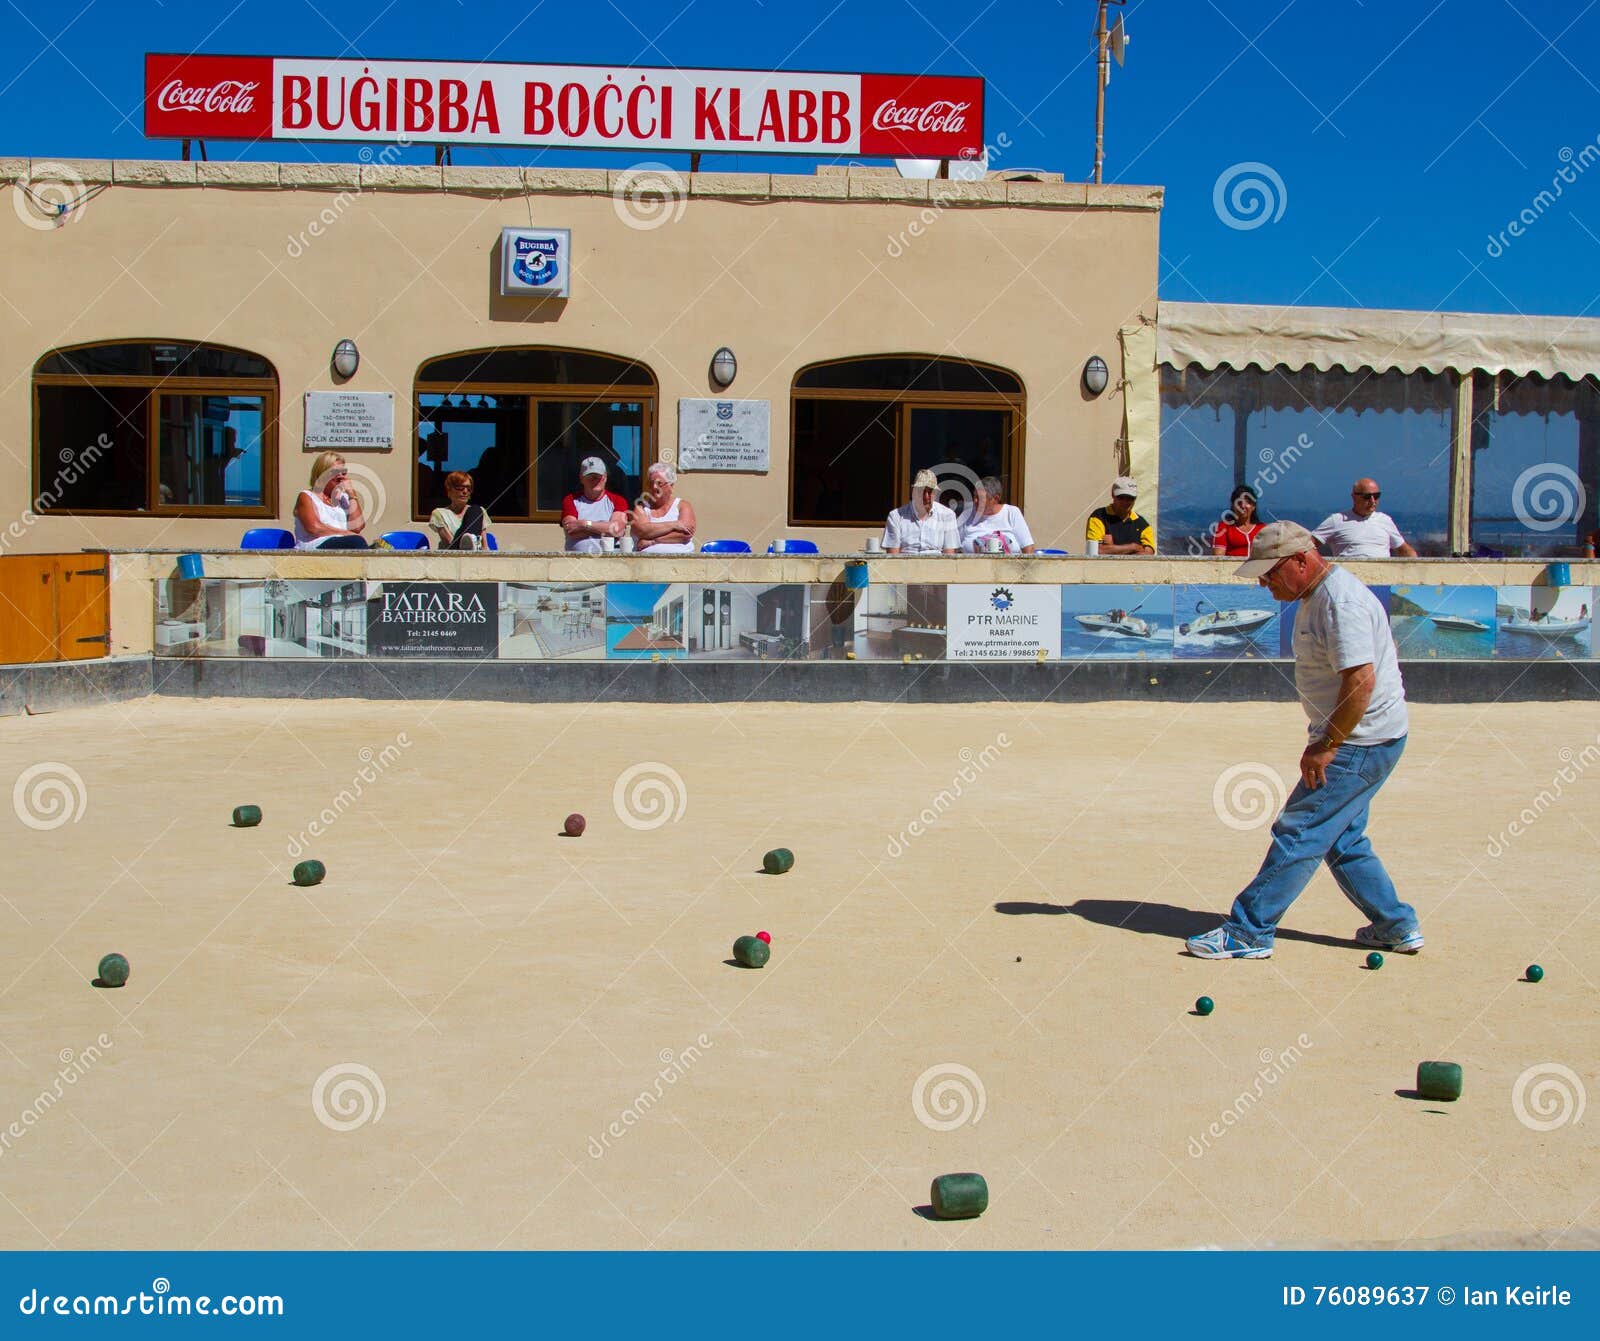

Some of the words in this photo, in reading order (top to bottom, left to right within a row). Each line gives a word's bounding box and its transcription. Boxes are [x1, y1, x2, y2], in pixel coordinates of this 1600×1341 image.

[157, 79, 260, 113] Coca-Cola
[281, 67, 501, 135] BUĠIBBA
[524, 74, 673, 139] BOĊĊI
[694, 86, 852, 145] KLABB
[872, 98, 970, 133] Coca-Cola
[383, 592, 485, 612] TATARA
[382, 611, 487, 623] BATHROOMS
[967, 615, 993, 625] PTR
[995, 615, 1038, 625] MARINE
[989, 629, 1015, 637] RABAT
[954, 649, 968, 657] Tel:
[970, 649, 988, 657] 2145
[989, 649, 1008, 657] 6236
